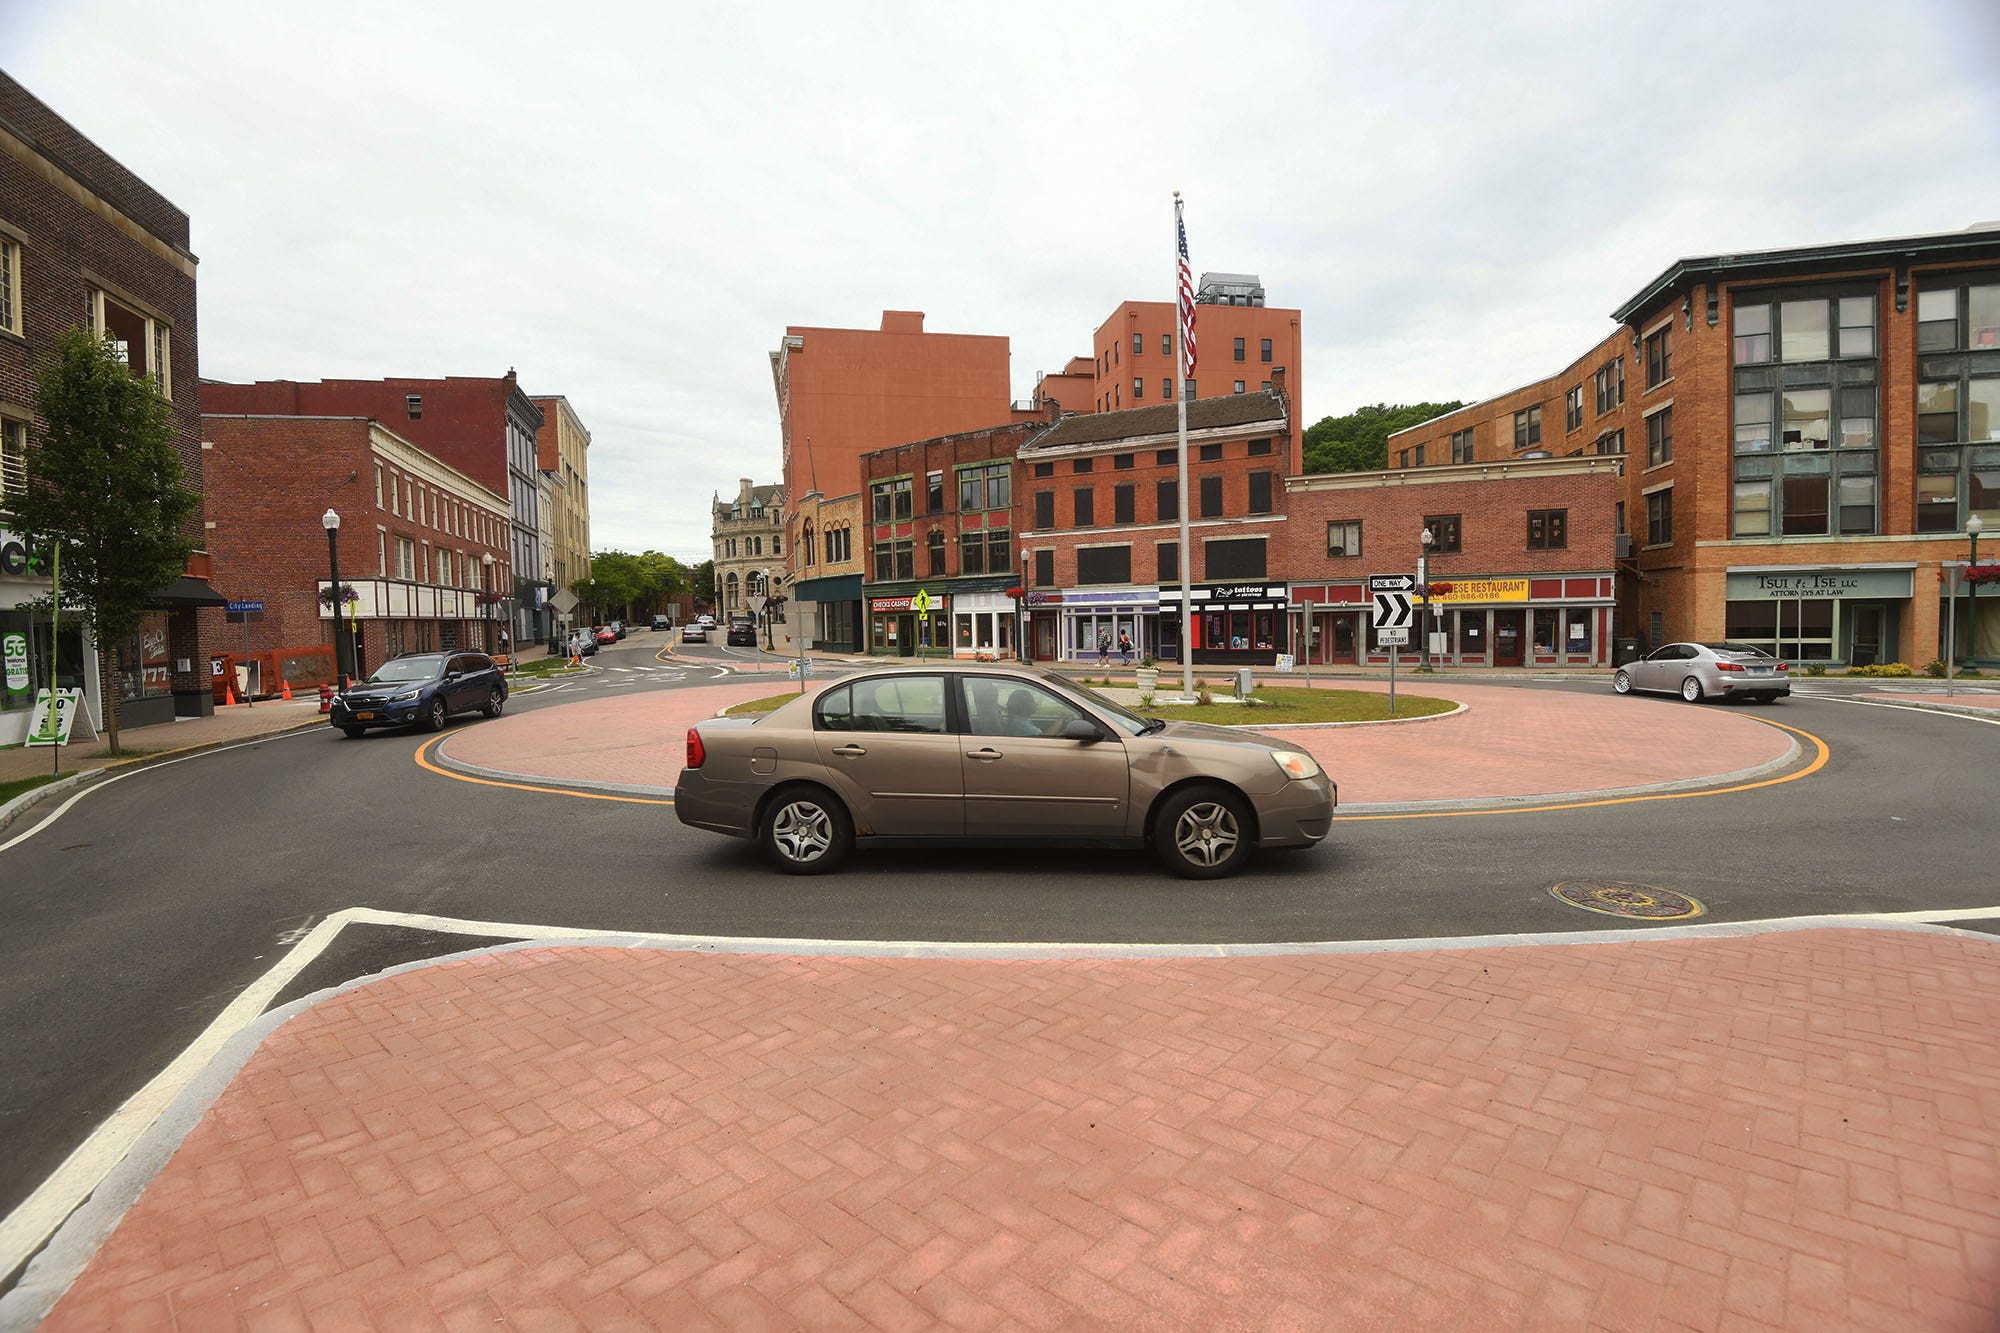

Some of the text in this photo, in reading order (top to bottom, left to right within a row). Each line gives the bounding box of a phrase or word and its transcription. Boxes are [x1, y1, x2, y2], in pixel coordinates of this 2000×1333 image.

[1374, 580, 1386, 588] ONE
[1471, 581, 1525, 593] RESTAURANT
[1756, 575, 1788, 589] TSUI
[1810, 574, 1836, 588] TSE
[1841, 580, 1858, 588] LLC
[891, 600, 909, 608] CASHED
[4, 640, 26, 657] 5G
